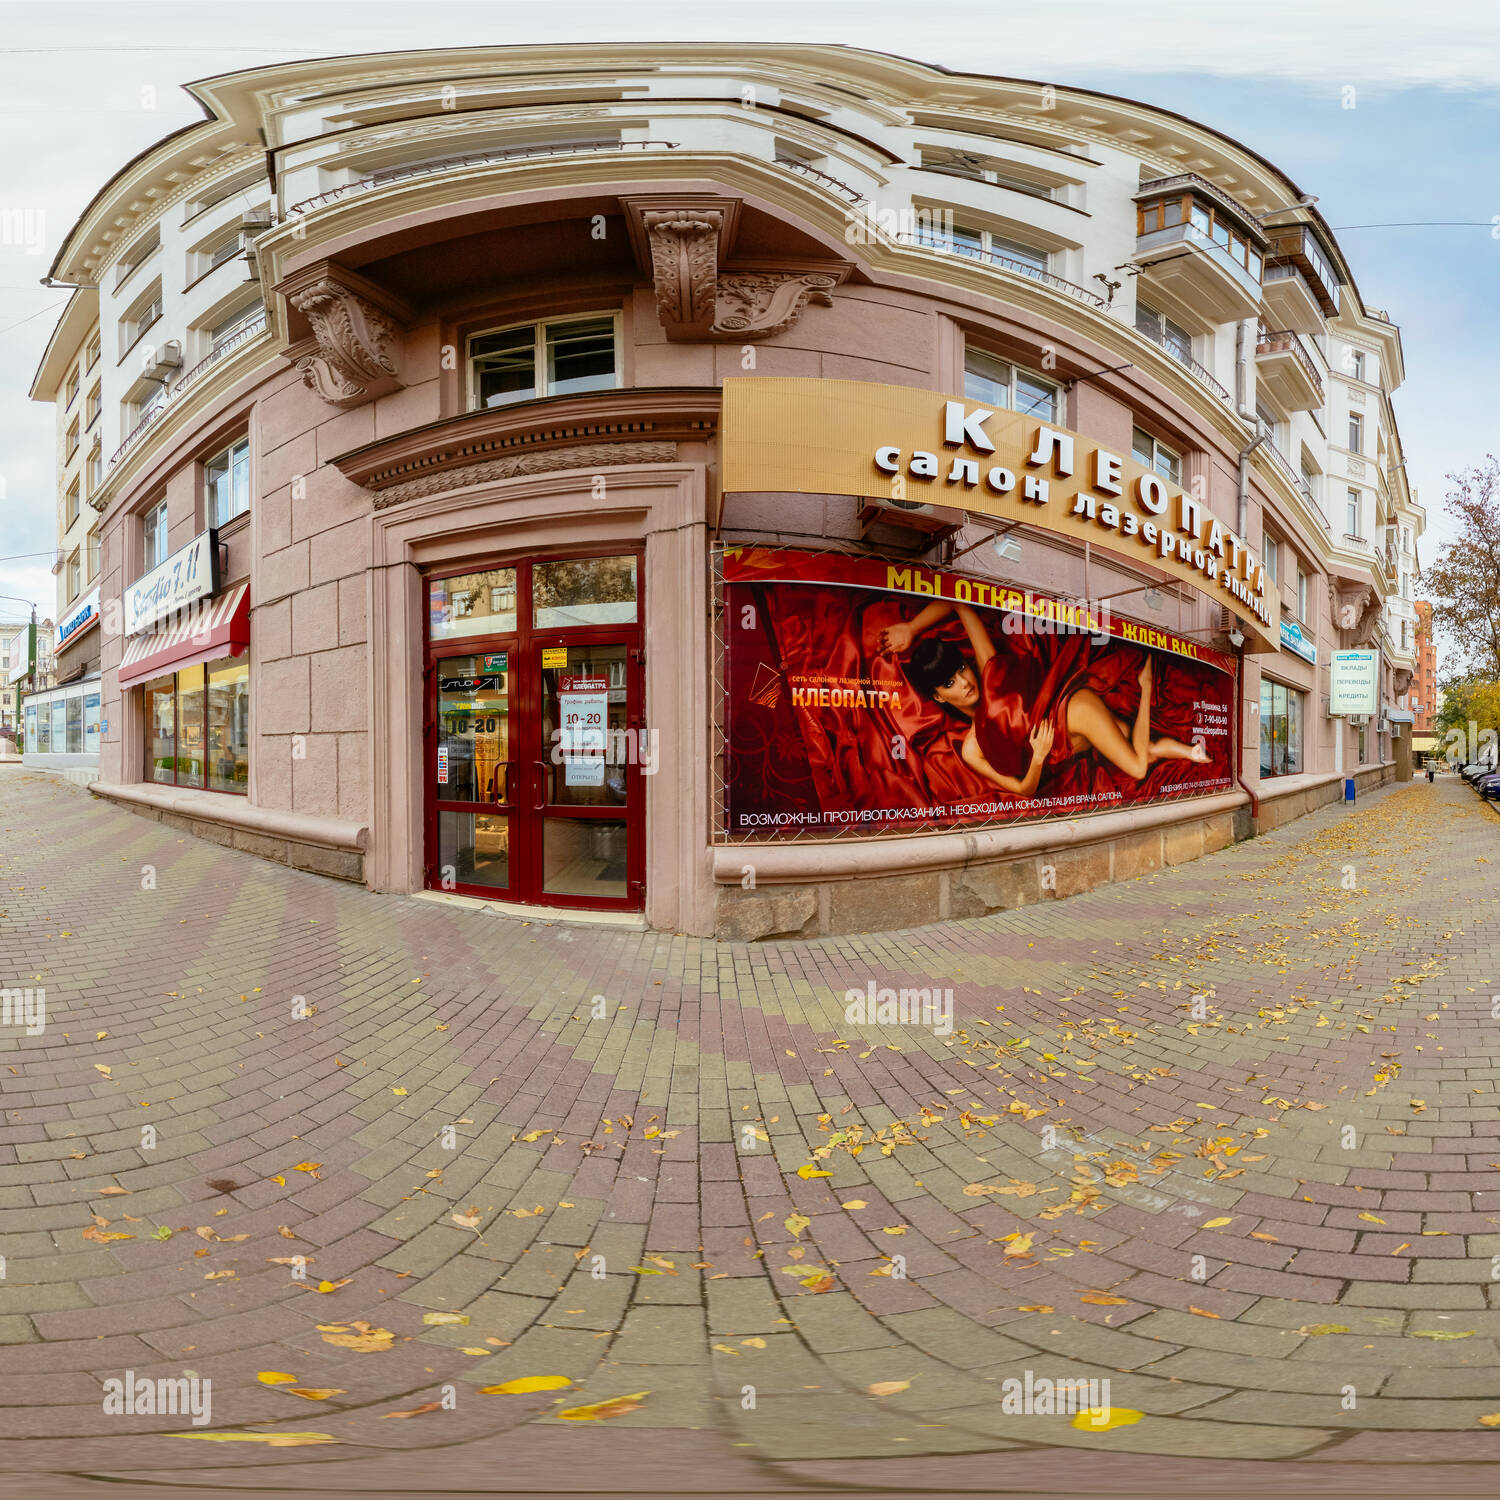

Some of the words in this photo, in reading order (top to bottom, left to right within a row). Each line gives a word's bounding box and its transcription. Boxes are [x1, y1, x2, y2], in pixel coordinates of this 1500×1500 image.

[944, 400, 1265, 598] КЛЕОПАТРА
[873, 445, 1049, 505] салон
[1072, 491, 1217, 580] лазерной
[1222, 569, 1273, 628] эпиляции
[886, 565, 942, 595] МЫ
[954, 578, 1099, 634] ОТКРЫЛИСЬ
[1121, 621, 1167, 650] ЖДЕМ
[1171, 637, 1198, 659] ВАС!
[792, 675, 808, 683] сеть
[809, 676, 838, 684] салонов
[839, 677, 871, 686] лазерной
[872, 679, 903, 687] эпиляции
[791, 687, 902, 710] КЛЕОПАТРА
[1338, 692, 1369, 700] КРЕДИТЫ
[450, 718, 496, 734] 10-20
[740, 812, 821, 826] ВОЗМОЖНЫ
[823, 805, 948, 823] ПРОТИВОПОКАЗАНИЯ.
[950, 801, 1014, 816] НЕОБХОДИМА
[1015, 795, 1076, 811] КОНСУЛЬТАЦИЯ
[1076, 793, 1097, 805] ВРАЧА
